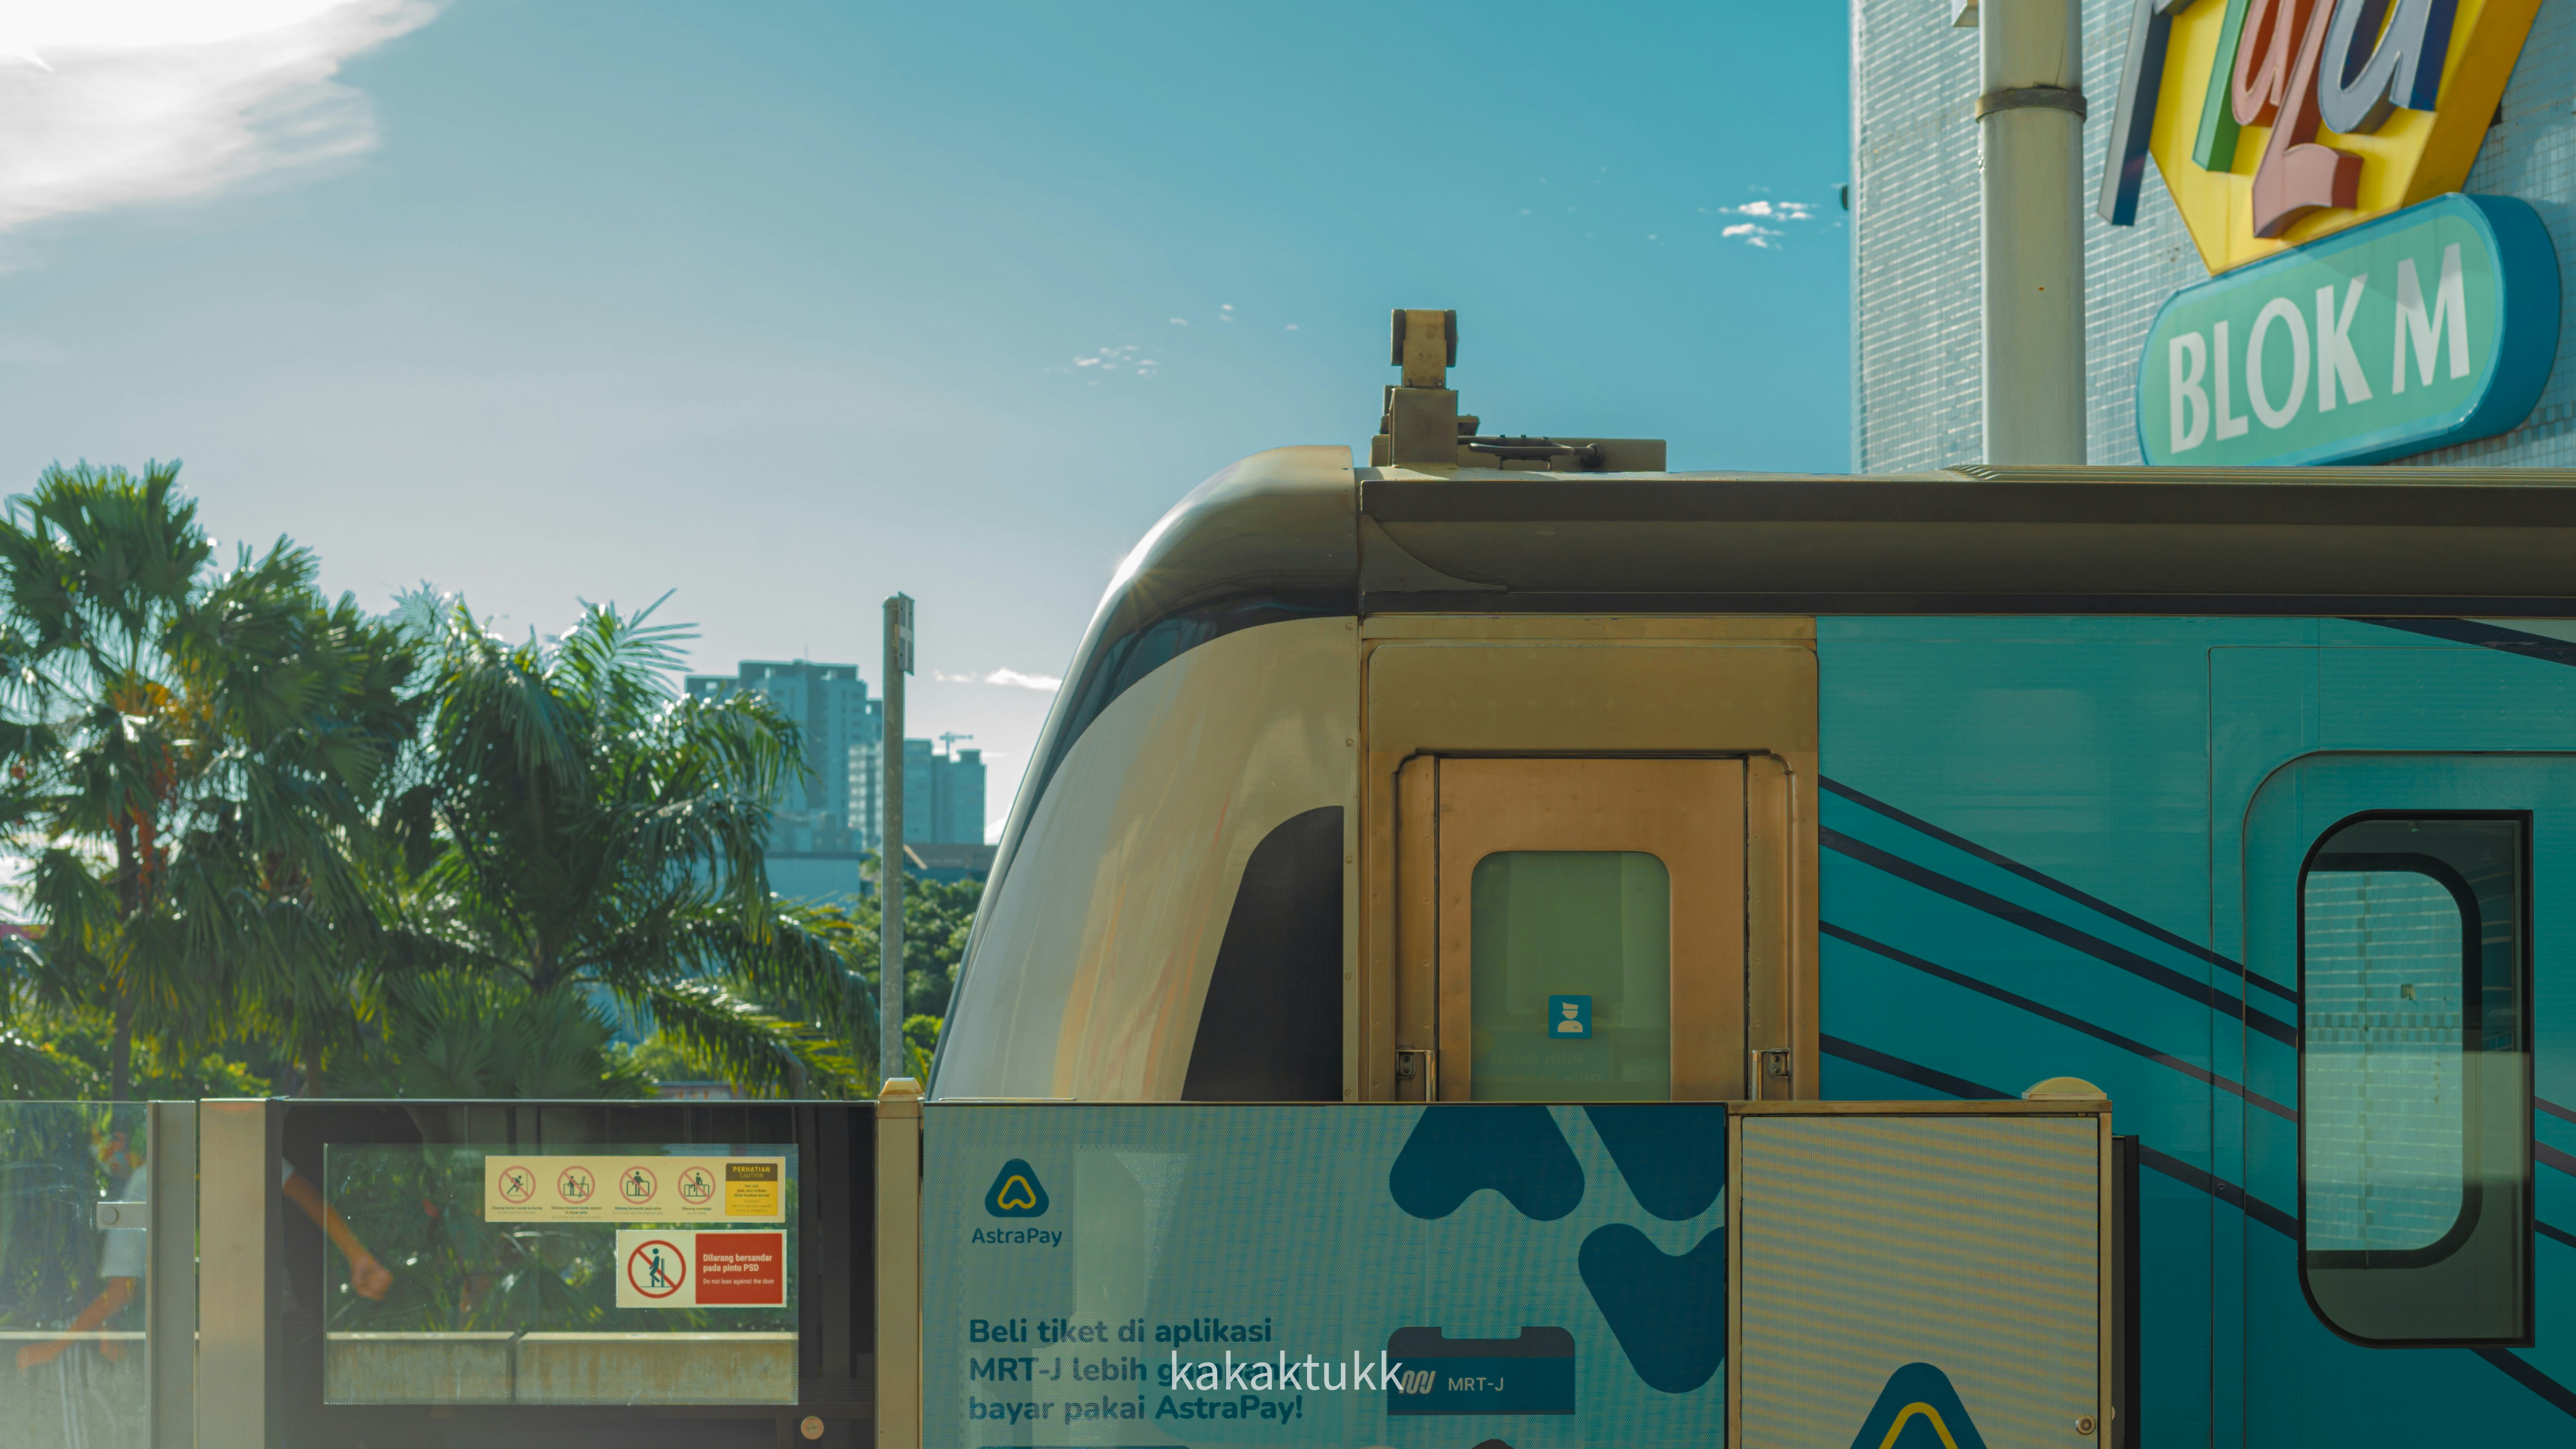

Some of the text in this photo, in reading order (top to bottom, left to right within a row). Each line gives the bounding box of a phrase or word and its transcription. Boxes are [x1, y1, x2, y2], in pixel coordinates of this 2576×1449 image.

[2169, 242, 2470, 455] BLOK M
[971, 1227, 1063, 1248] AstraPay
[703, 1253, 772, 1263] Dilarang bersandar
[703, 1264, 721, 1273] pada
[723, 1264, 741, 1273] pintu
[969, 1317, 1272, 1348] Beli tiket di aplikasi
[969, 1358, 1061, 1382] MRT-J
[1073, 1357, 1147, 1382] lebih
[1448, 1377, 1504, 1392] MRT-J
[969, 1394, 1303, 1425] bayar pakai AstraPay!
